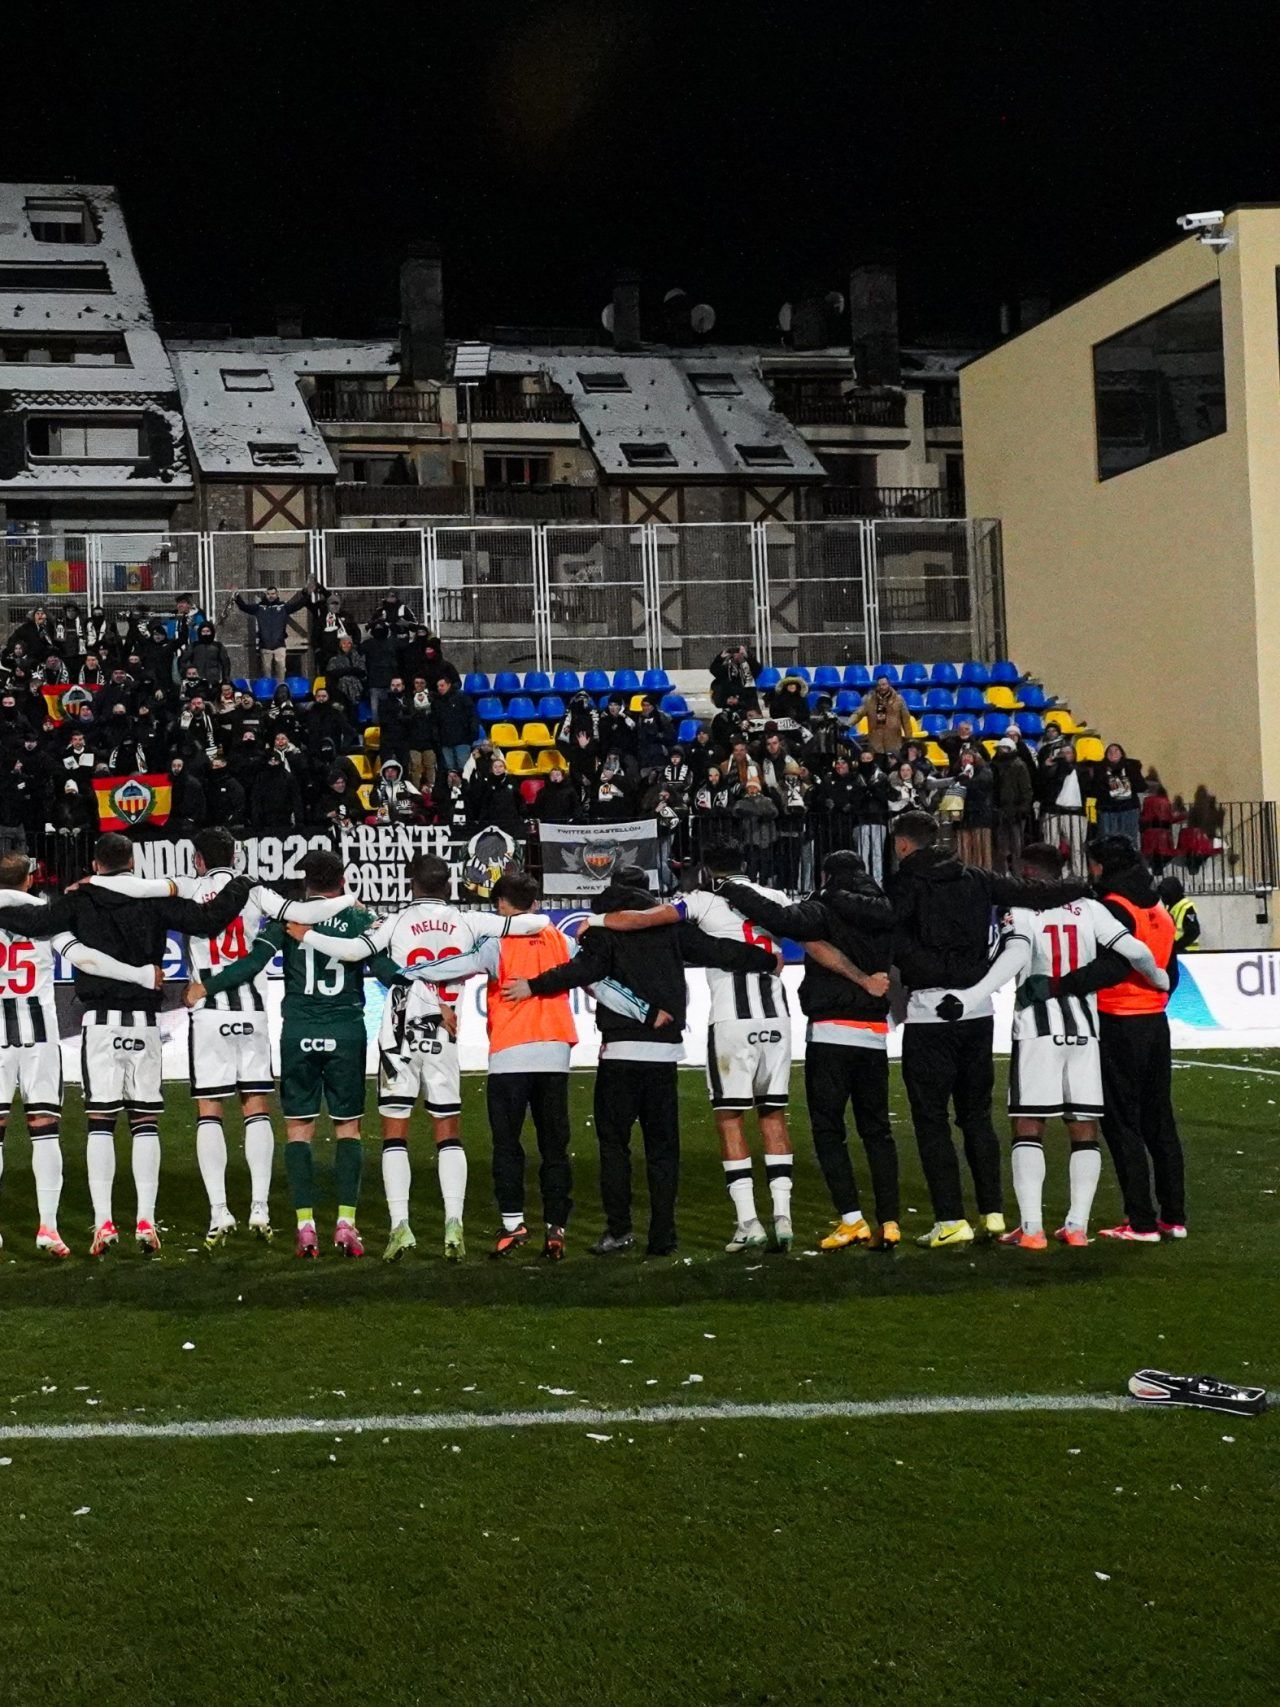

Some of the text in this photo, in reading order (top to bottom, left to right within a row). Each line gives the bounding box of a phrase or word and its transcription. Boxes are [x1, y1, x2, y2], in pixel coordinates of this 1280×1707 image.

[339, 825, 452, 866] FRENTE
[411, 920, 457, 936] MELLOT
[208, 915, 249, 965] 14
[1043, 924, 1079, 984] 11
[299, 942, 345, 997] 13
[219, 1022, 254, 1036] CCD
[113, 1037, 145, 1051] CCD
[300, 1038, 337, 1052] CCD
[748, 1031, 782, 1044] CCD
